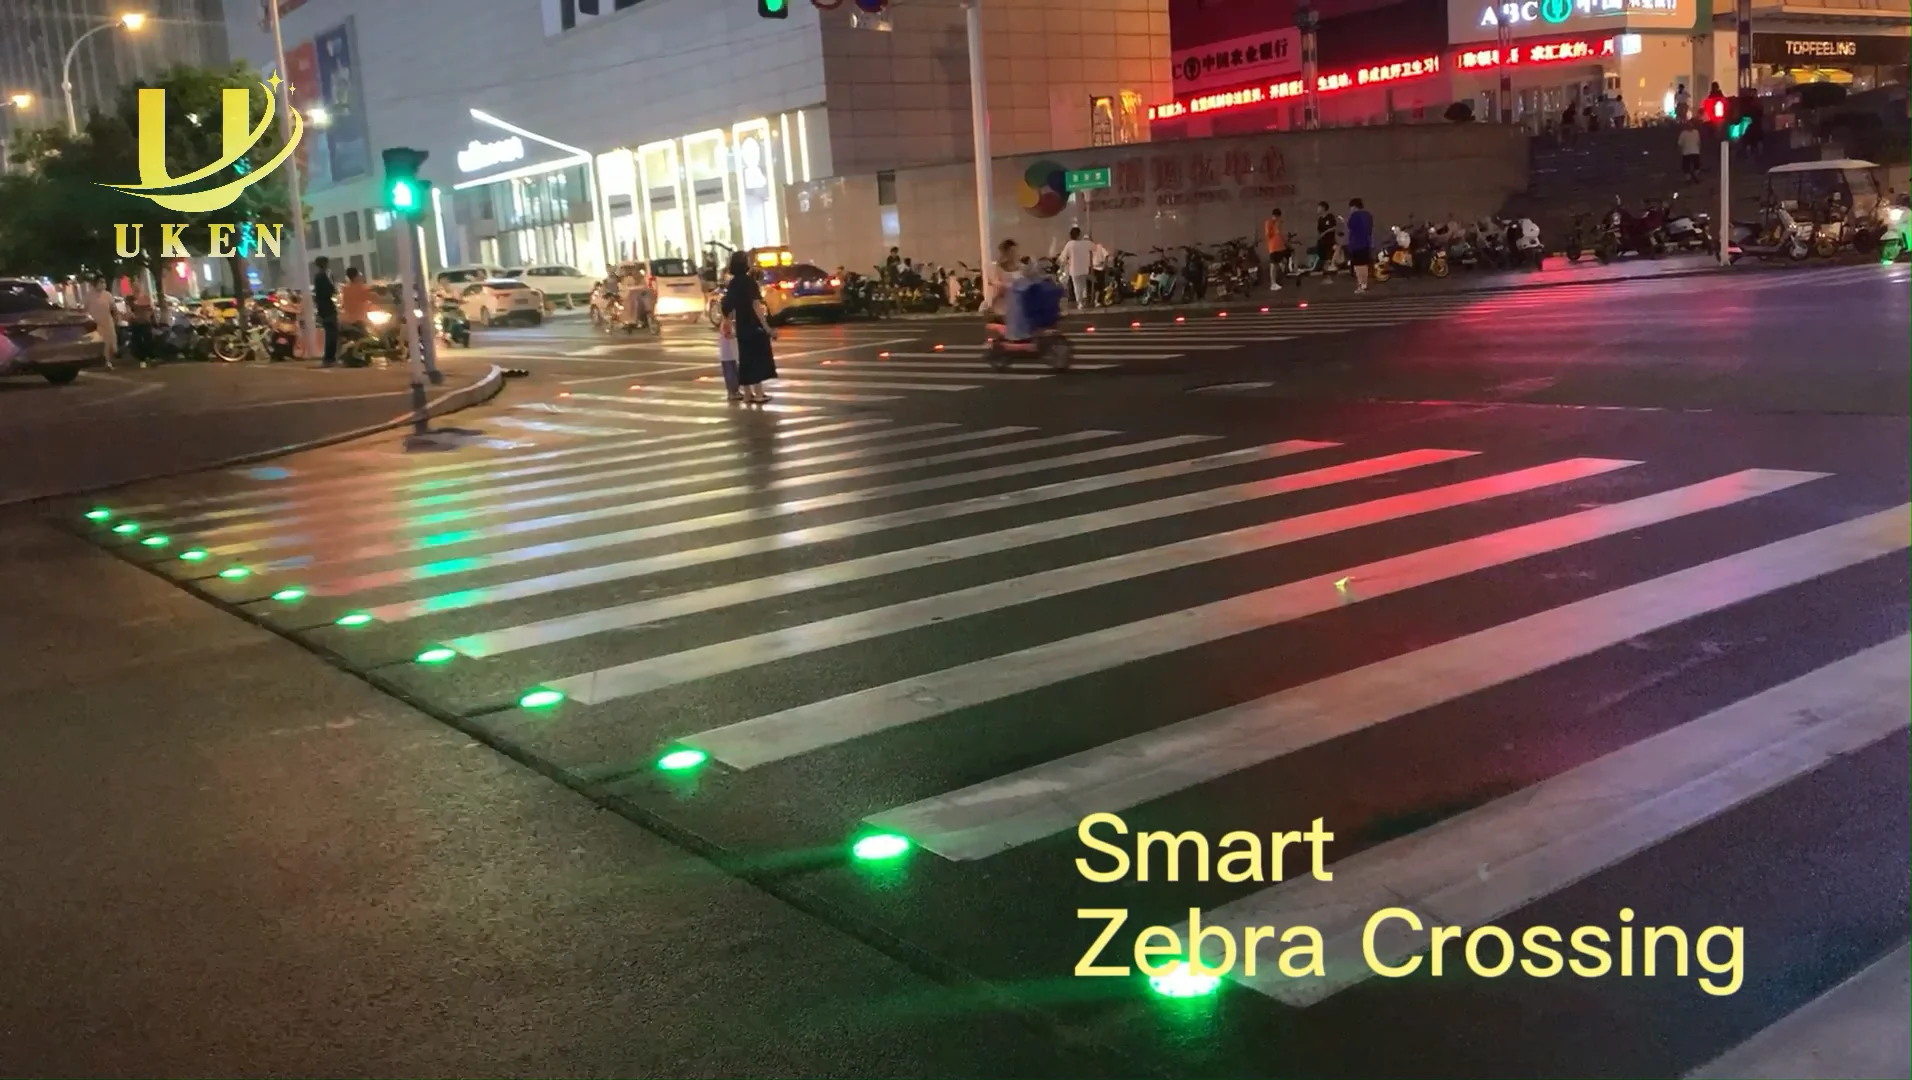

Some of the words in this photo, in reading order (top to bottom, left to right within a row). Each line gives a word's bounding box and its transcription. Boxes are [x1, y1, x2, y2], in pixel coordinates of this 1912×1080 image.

[1202, 38, 1289, 72] 中国农业银行
[1785, 40, 1857, 56] TOPFEELING
